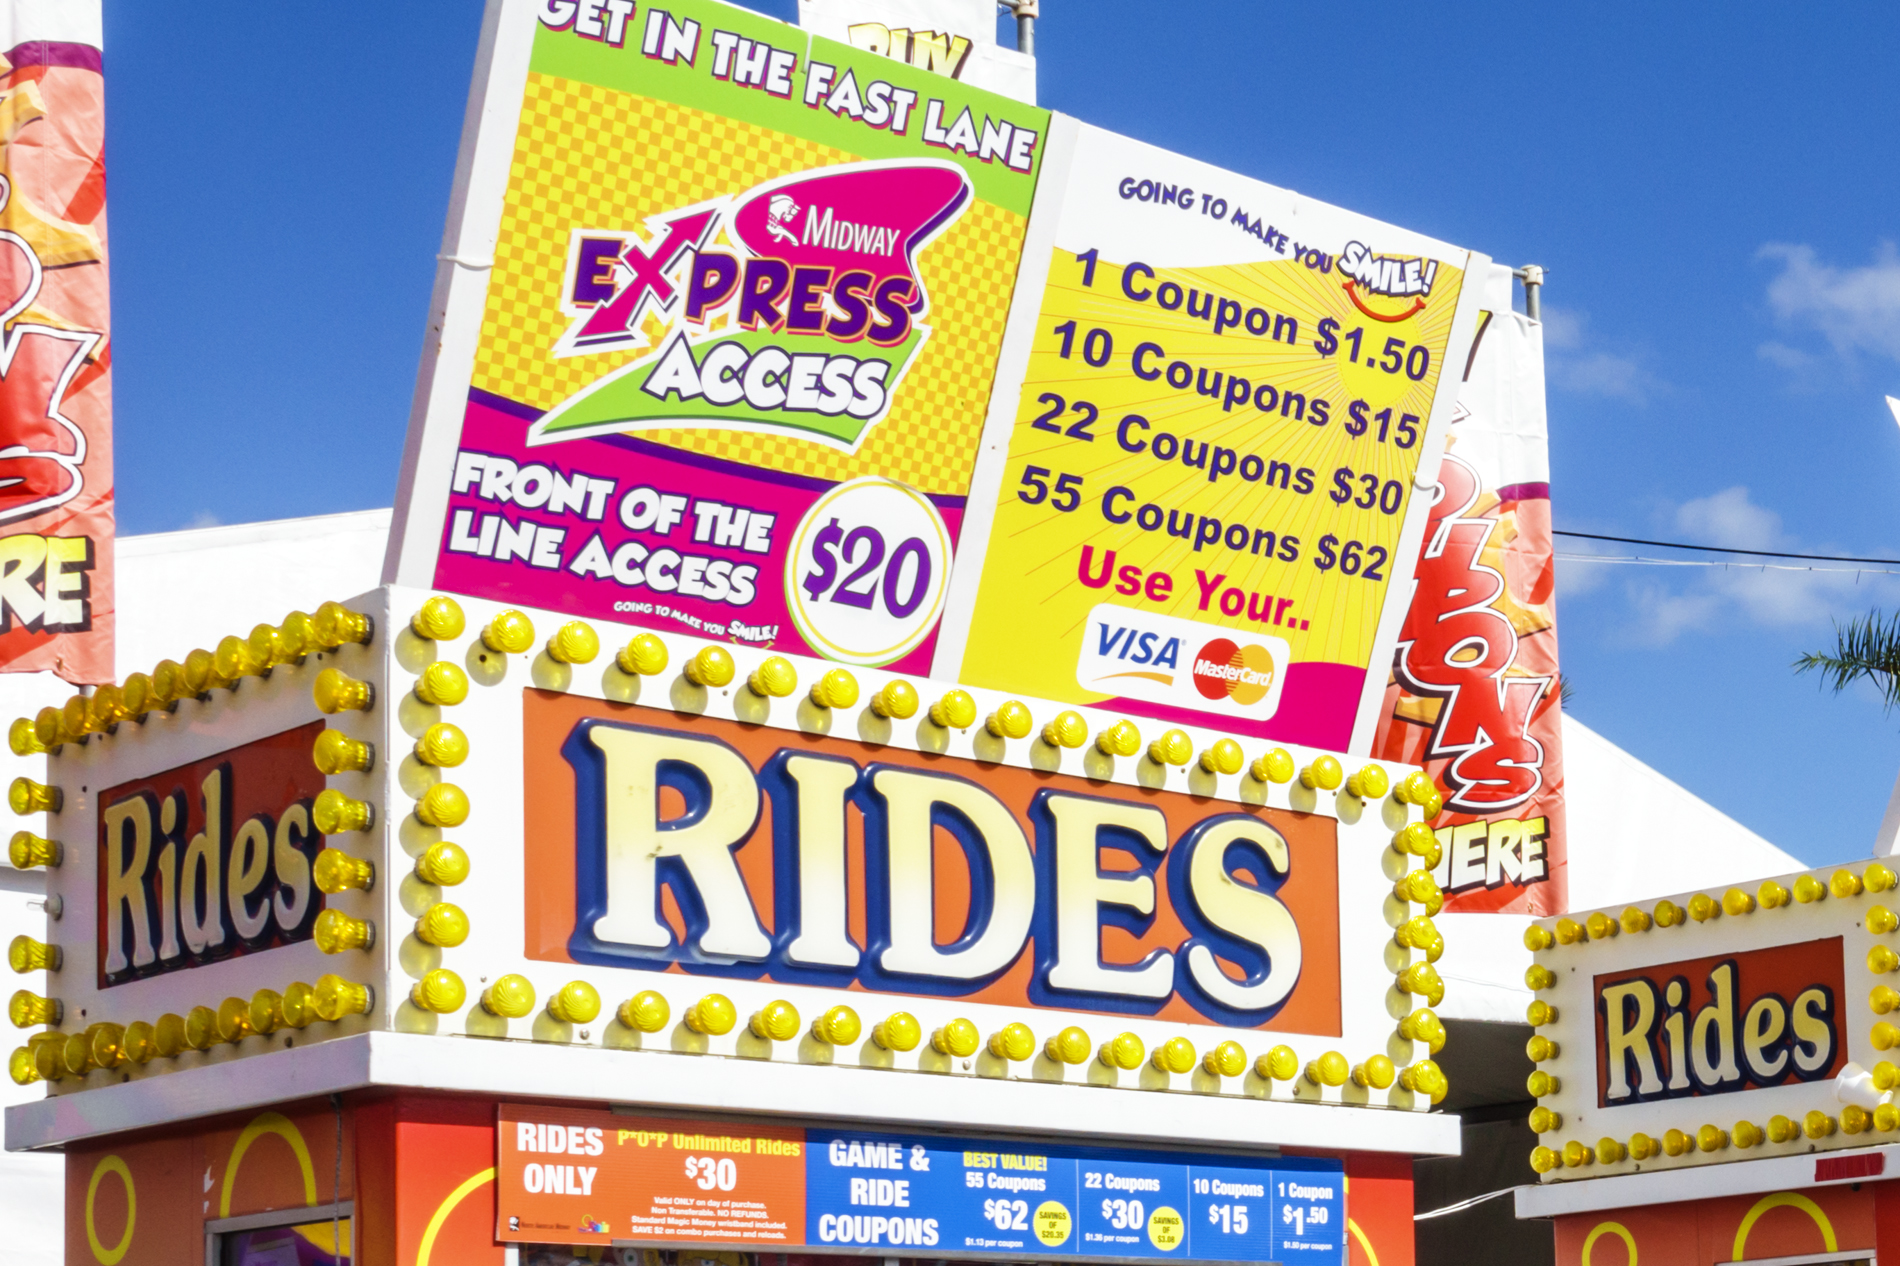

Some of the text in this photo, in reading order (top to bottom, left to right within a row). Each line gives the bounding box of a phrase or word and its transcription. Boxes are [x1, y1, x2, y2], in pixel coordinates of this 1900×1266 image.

[538, 0, 634, 47] GET
[642, 10, 700, 67] IN
[712, 30, 797, 96] THE
[804, 61, 916, 133] FAST
[922, 99, 1036, 173] LANE
[1119, 175, 1439, 296] GOING TO MAKE YOU SMILE!
[571, 206, 918, 348] EXPRESS
[1075, 248, 1430, 382] 1 Coupon $1.50
[640, 331, 892, 418] ACCESS
[1053, 320, 1421, 449] 10 Coupons $15
[1032, 392, 1402, 516] 22 Coupons $30
[452, 449, 775, 555] FRONT OF THE
[1017, 465, 1388, 581] 55 Coupons $62
[448, 510, 758, 606] LINE ACCESS
[802, 517, 932, 620] $20
[1078, 544, 1173, 602] Use
[1097, 622, 1272, 689] VISA MasterCard
[102, 770, 317, 988] Rides
[566, 714, 1305, 1024] RIDES
[1599, 961, 1838, 1103] Rides
[517, 1122, 604, 1156] RIDES
[673, 1133, 752, 1154] Unlimited
[756, 1138, 801, 1156] Rides
[829, 1139, 931, 1171] GAME &
[963, 1151, 1047, 1171] BEST VALUE!
[524, 1163, 597, 1195] ONLY
[685, 1155, 737, 1191] $30
[851, 1178, 910, 1207] RIDE
[966, 1171, 1046, 1193] 55 Coupons
[1085, 1172, 1160, 1193] 22 Coupons
[1193, 1179, 1264, 1199] 10 Coupons
[1278, 1182, 1333, 1202] 1 Coupon
[819, 1214, 939, 1246] COUPONS
[984, 1198, 1029, 1230] $62
[1102, 1198, 1144, 1230] $30
[1209, 1203, 1248, 1234] $15
[1283, 1204, 1328, 1235] $1.50
